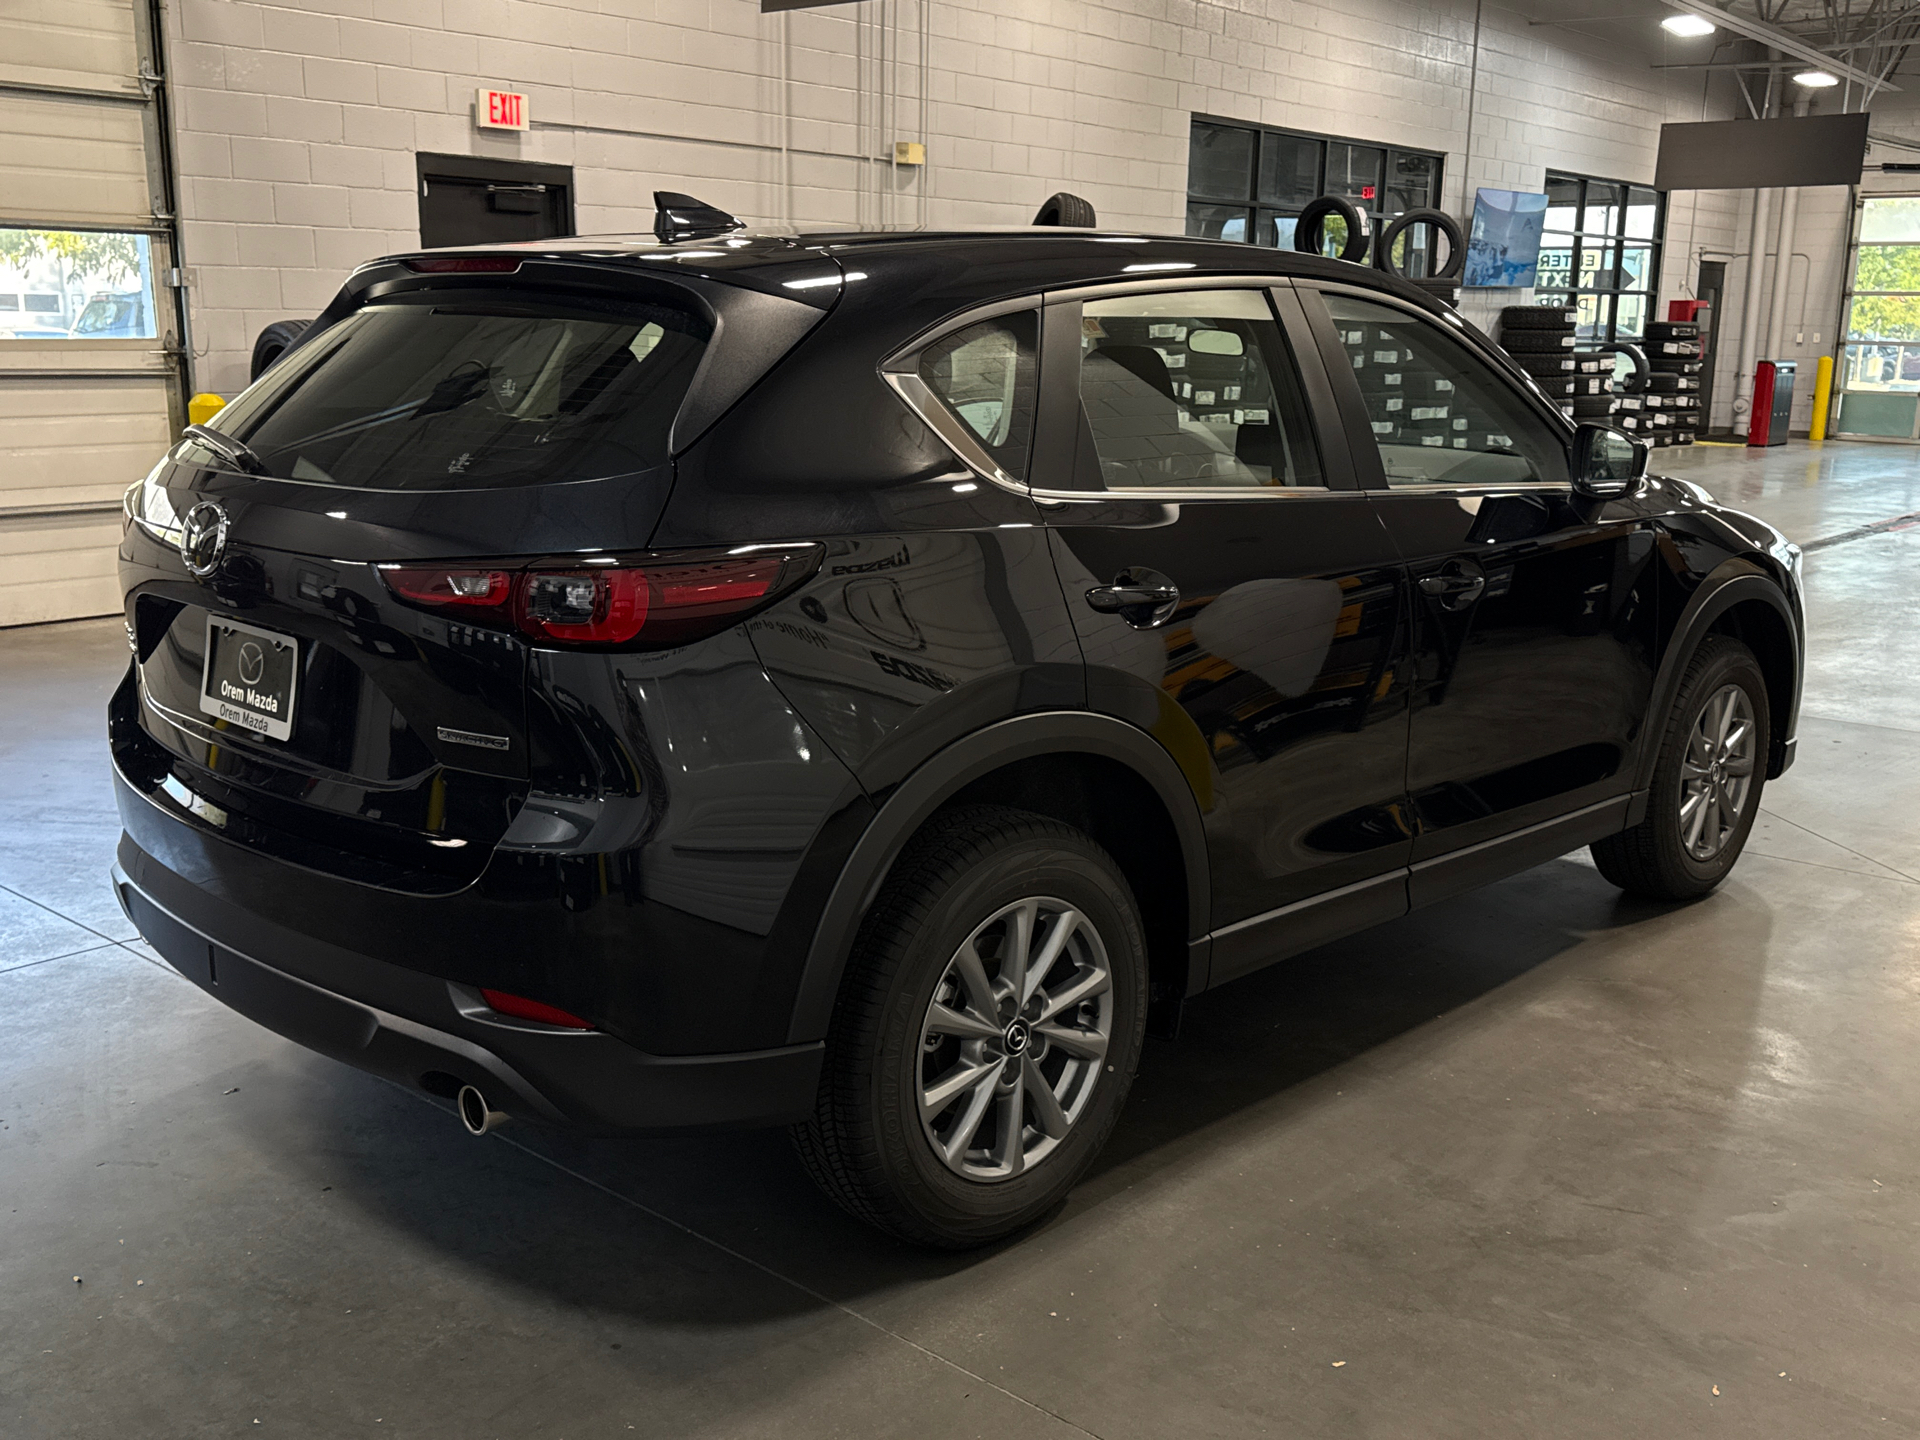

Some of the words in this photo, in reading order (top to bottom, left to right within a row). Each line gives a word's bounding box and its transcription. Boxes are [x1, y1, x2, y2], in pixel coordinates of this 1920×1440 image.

[488, 91, 522, 126] EXIT
[221, 680, 244, 702] Orem
[246, 688, 278, 713] Mazda
[220, 704, 240, 723] Orem
[242, 711, 268, 732] Mazda
[881, 990, 920, 1187] YOKOHAMA
